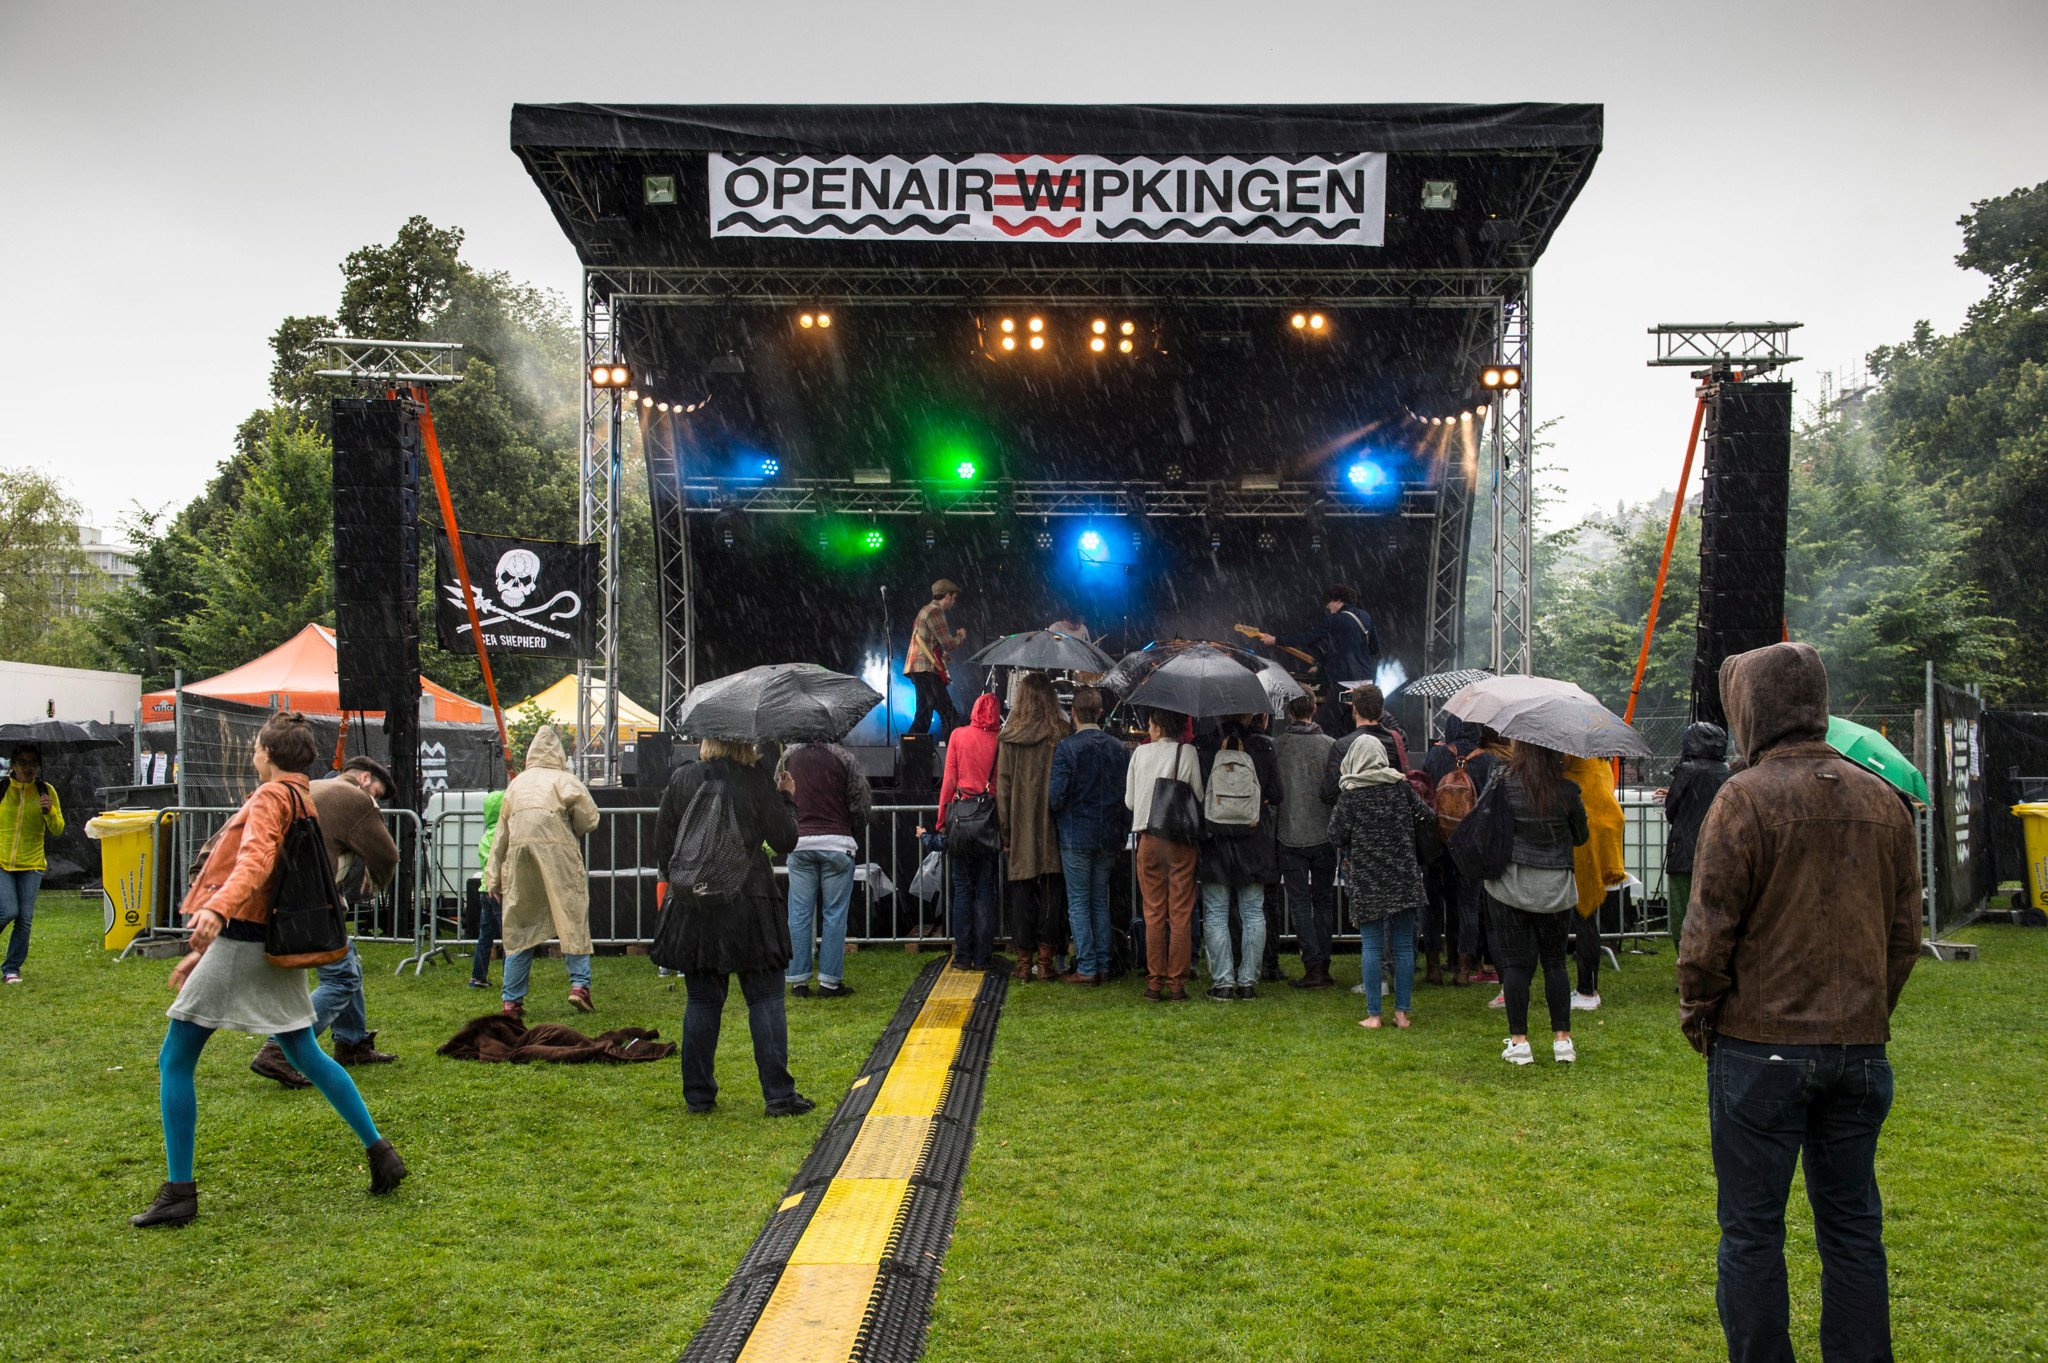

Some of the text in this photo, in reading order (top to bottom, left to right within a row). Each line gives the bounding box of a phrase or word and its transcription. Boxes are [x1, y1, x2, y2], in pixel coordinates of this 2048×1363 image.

[724, 167, 1365, 214] OPENAIR WIPKINGEN
[499, 635, 547, 648] SHEPHERD
